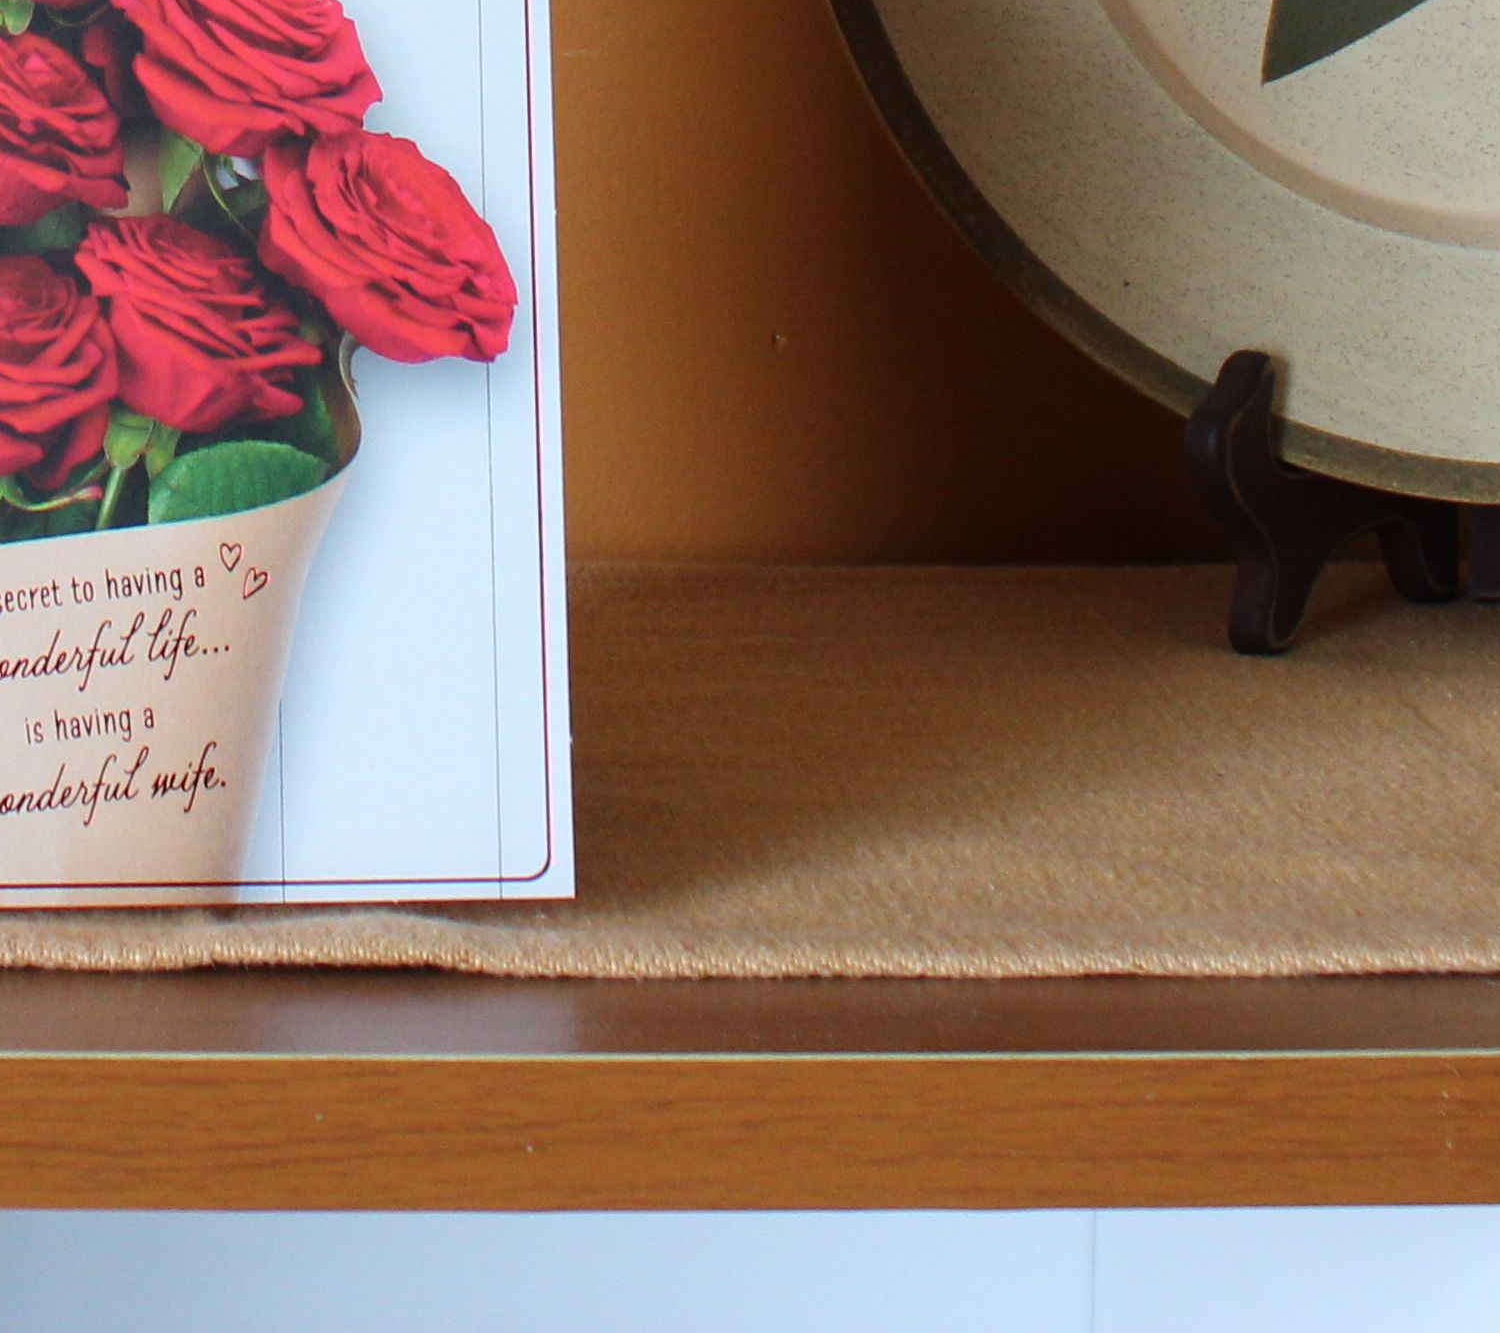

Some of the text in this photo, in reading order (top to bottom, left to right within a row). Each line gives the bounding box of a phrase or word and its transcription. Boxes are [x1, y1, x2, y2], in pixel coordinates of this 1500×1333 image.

[72, 577, 94, 604] to
[104, 566, 183, 600] having
[194, 566, 205, 587] a
[147, 608, 230, 681] life...
[25, 707, 155, 744] is having a
[151, 741, 227, 813] wife.
